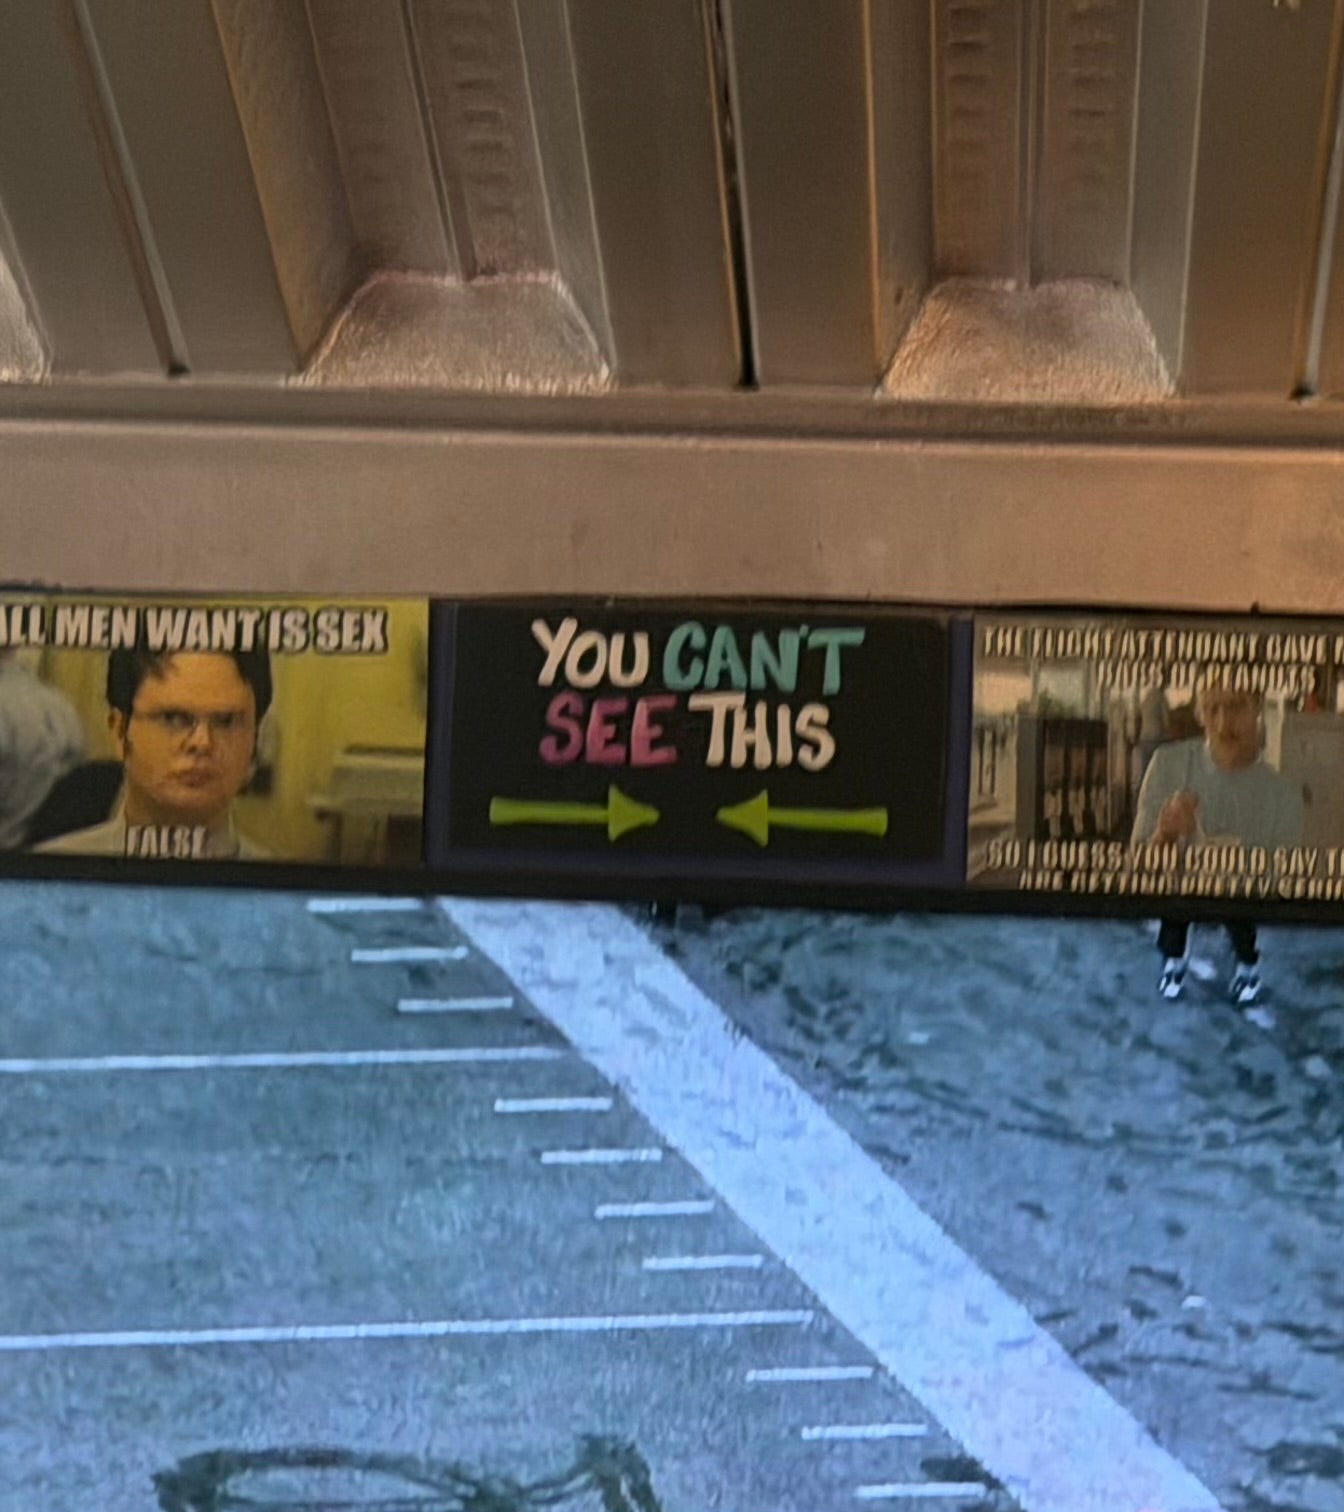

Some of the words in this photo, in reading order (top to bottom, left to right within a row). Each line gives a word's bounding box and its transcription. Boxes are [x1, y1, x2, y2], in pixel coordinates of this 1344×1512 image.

[56, 606, 138, 649] MEN
[144, 607, 258, 651] WANT
[268, 607, 309, 652] IS
[315, 609, 387, 653] SEX
[984, 626, 1022, 656] THE
[1033, 628, 1114, 659] FLIGHT
[1120, 629, 1257, 663] ATTENDANT
[1265, 634, 1327, 665] GAVE
[532, 617, 649, 688] YOU
[663, 621, 864, 695] CAN'T
[1097, 660, 1163, 690] BAGS
[1171, 661, 1197, 689] OF
[1206, 663, 1315, 692] PEANUTS
[540, 690, 678, 766] SEE
[688, 691, 835, 771] THIS
[986, 838, 1020, 869] SO
[1027, 838, 1036, 869] I
[1043, 839, 1123, 871] GUESS
[1129, 842, 1178, 872] YOU
[1185, 843, 1266, 874] COULD
[1273, 846, 1318, 876] SAY
